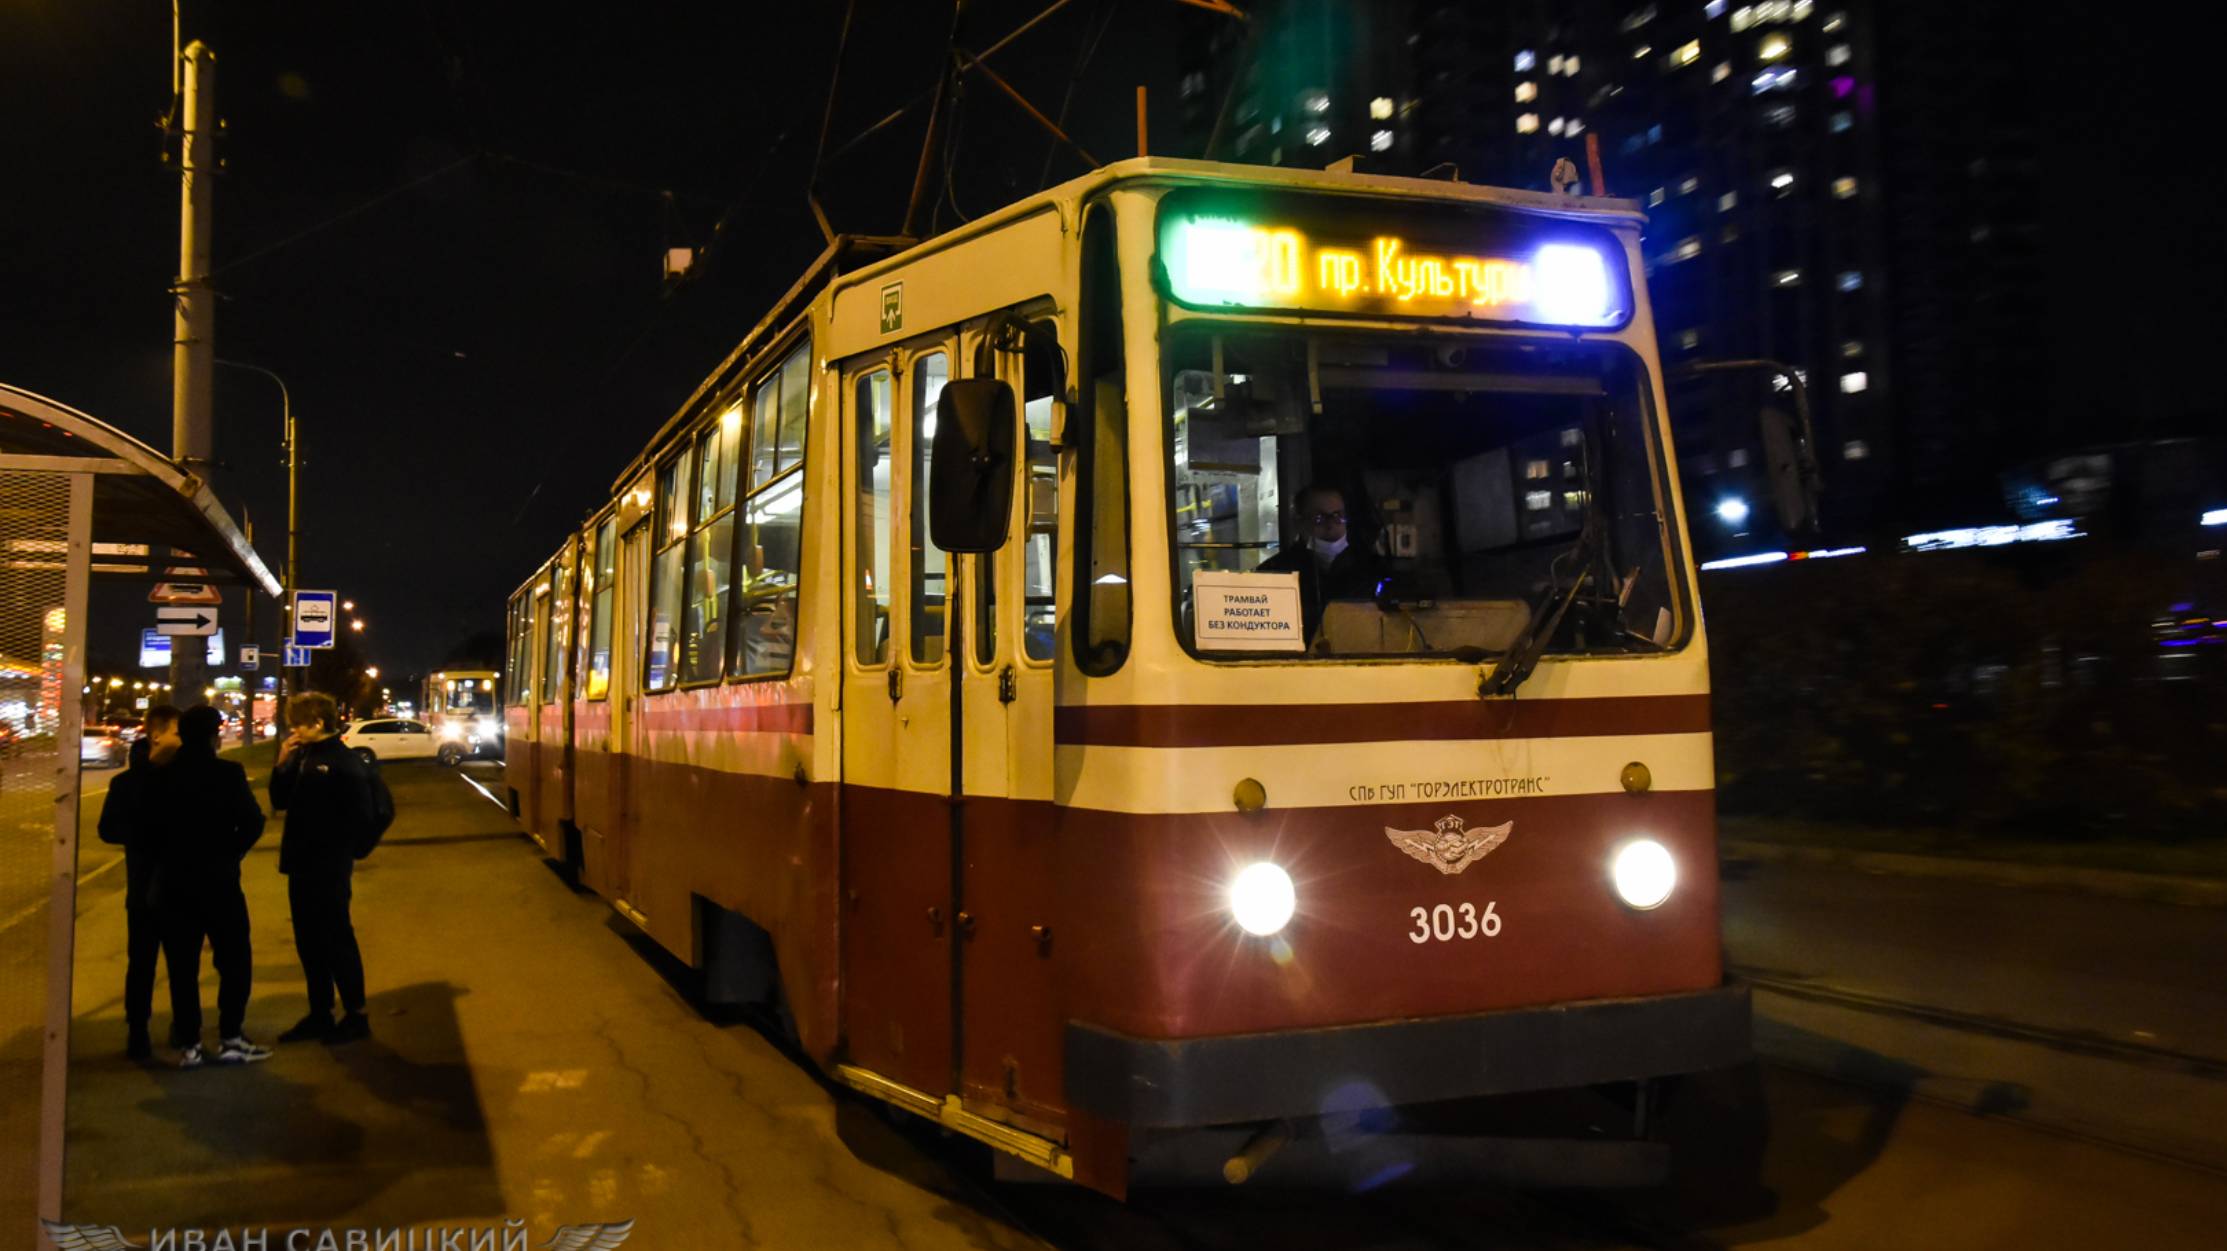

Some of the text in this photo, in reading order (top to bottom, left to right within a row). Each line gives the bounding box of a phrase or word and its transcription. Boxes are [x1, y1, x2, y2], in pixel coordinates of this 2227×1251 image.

[1317, 252, 1370, 297] пр.
[1223, 594, 1269, 604] ТРАМВАЙ
[1223, 608, 1271, 617] РАБОТАЕТ
[1208, 621, 1291, 632] БЕЗ КОНДУКТОРА
[1380, 783, 1405, 800] ГУП
[1408, 901, 1502, 944] 3036
